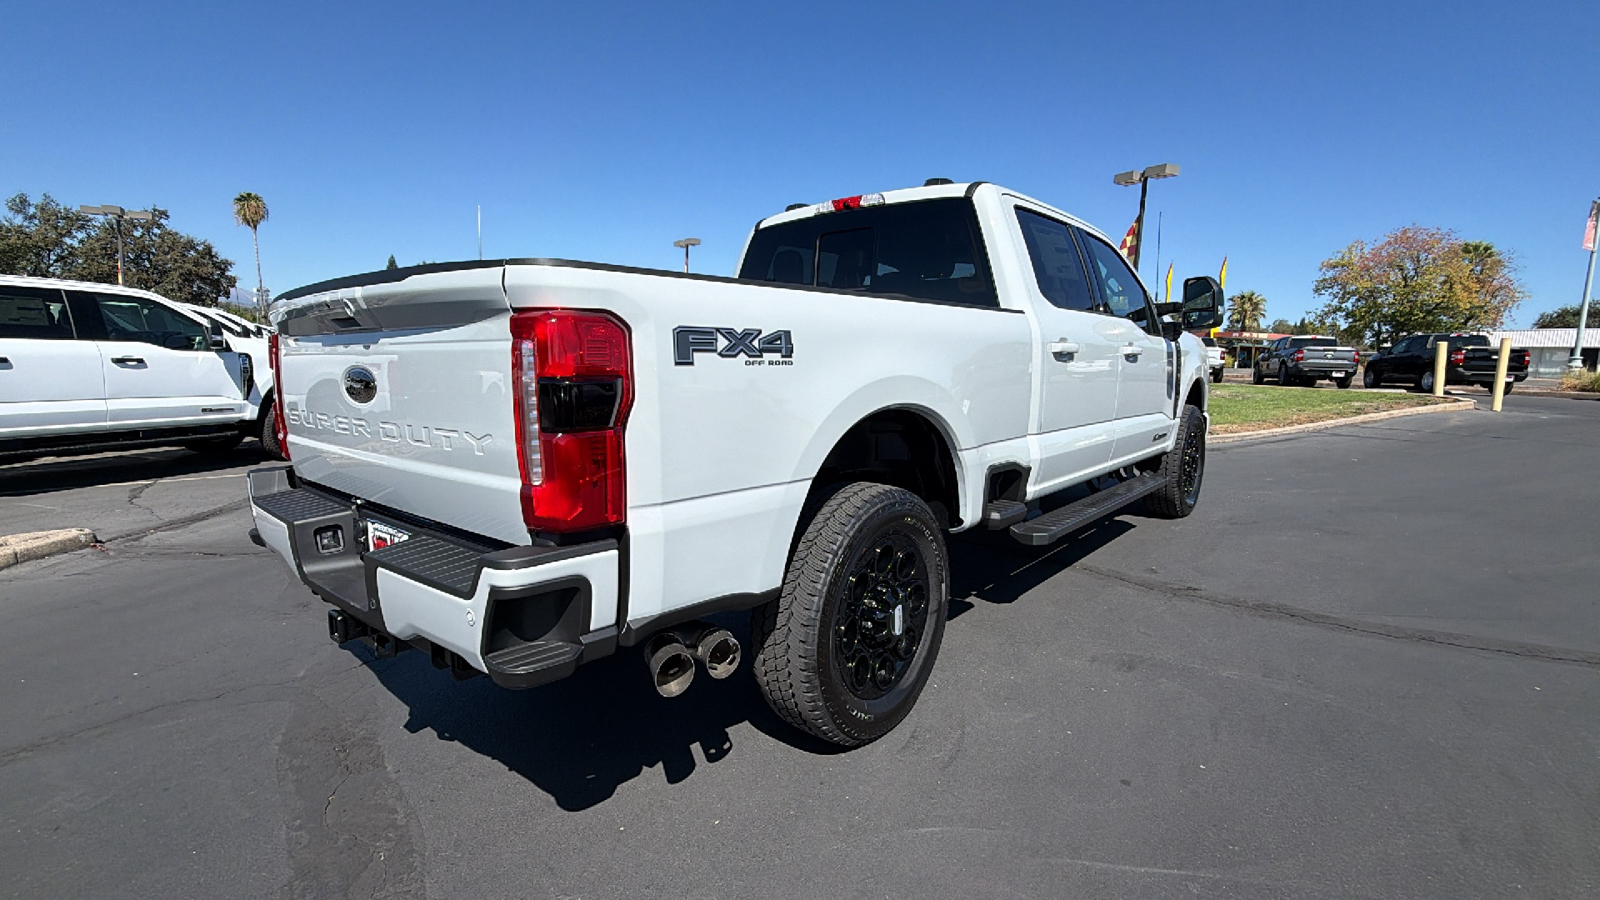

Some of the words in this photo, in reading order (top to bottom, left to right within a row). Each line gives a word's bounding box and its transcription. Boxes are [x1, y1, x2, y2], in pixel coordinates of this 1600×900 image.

[672, 325, 794, 366] FX4
[744, 359, 765, 367] OFF
[768, 359, 794, 367] ROAD
[288, 407, 371, 438] SUPER
[379, 420, 493, 456] DUTY
